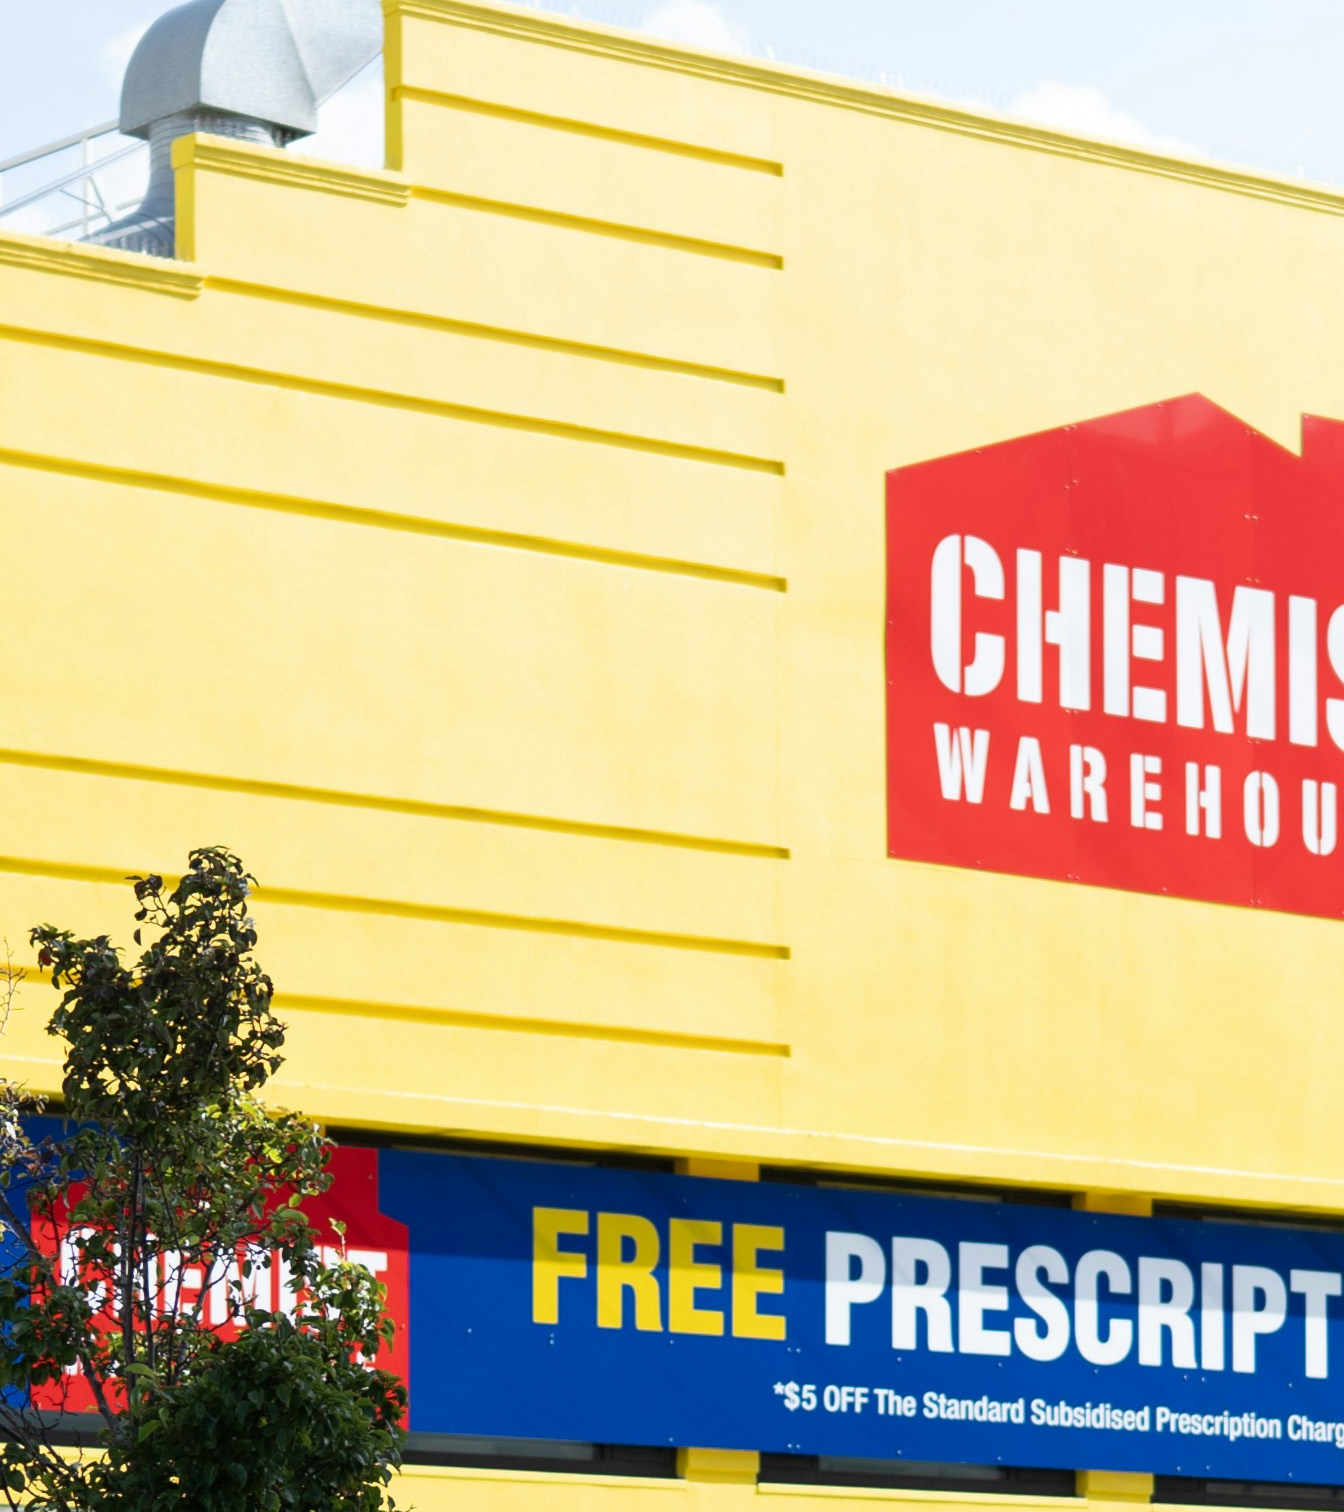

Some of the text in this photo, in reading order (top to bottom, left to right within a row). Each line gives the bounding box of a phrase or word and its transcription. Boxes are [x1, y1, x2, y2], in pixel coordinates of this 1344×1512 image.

[532, 1205, 787, 1341] FREE
[823, 1385, 869, 1413] OFF
[873, 1388, 916, 1417] The
[923, 1391, 1025, 1424] Standard
[1030, 1398, 1150, 1432] Subsidised
[1155, 1406, 1281, 1442] Prescription
